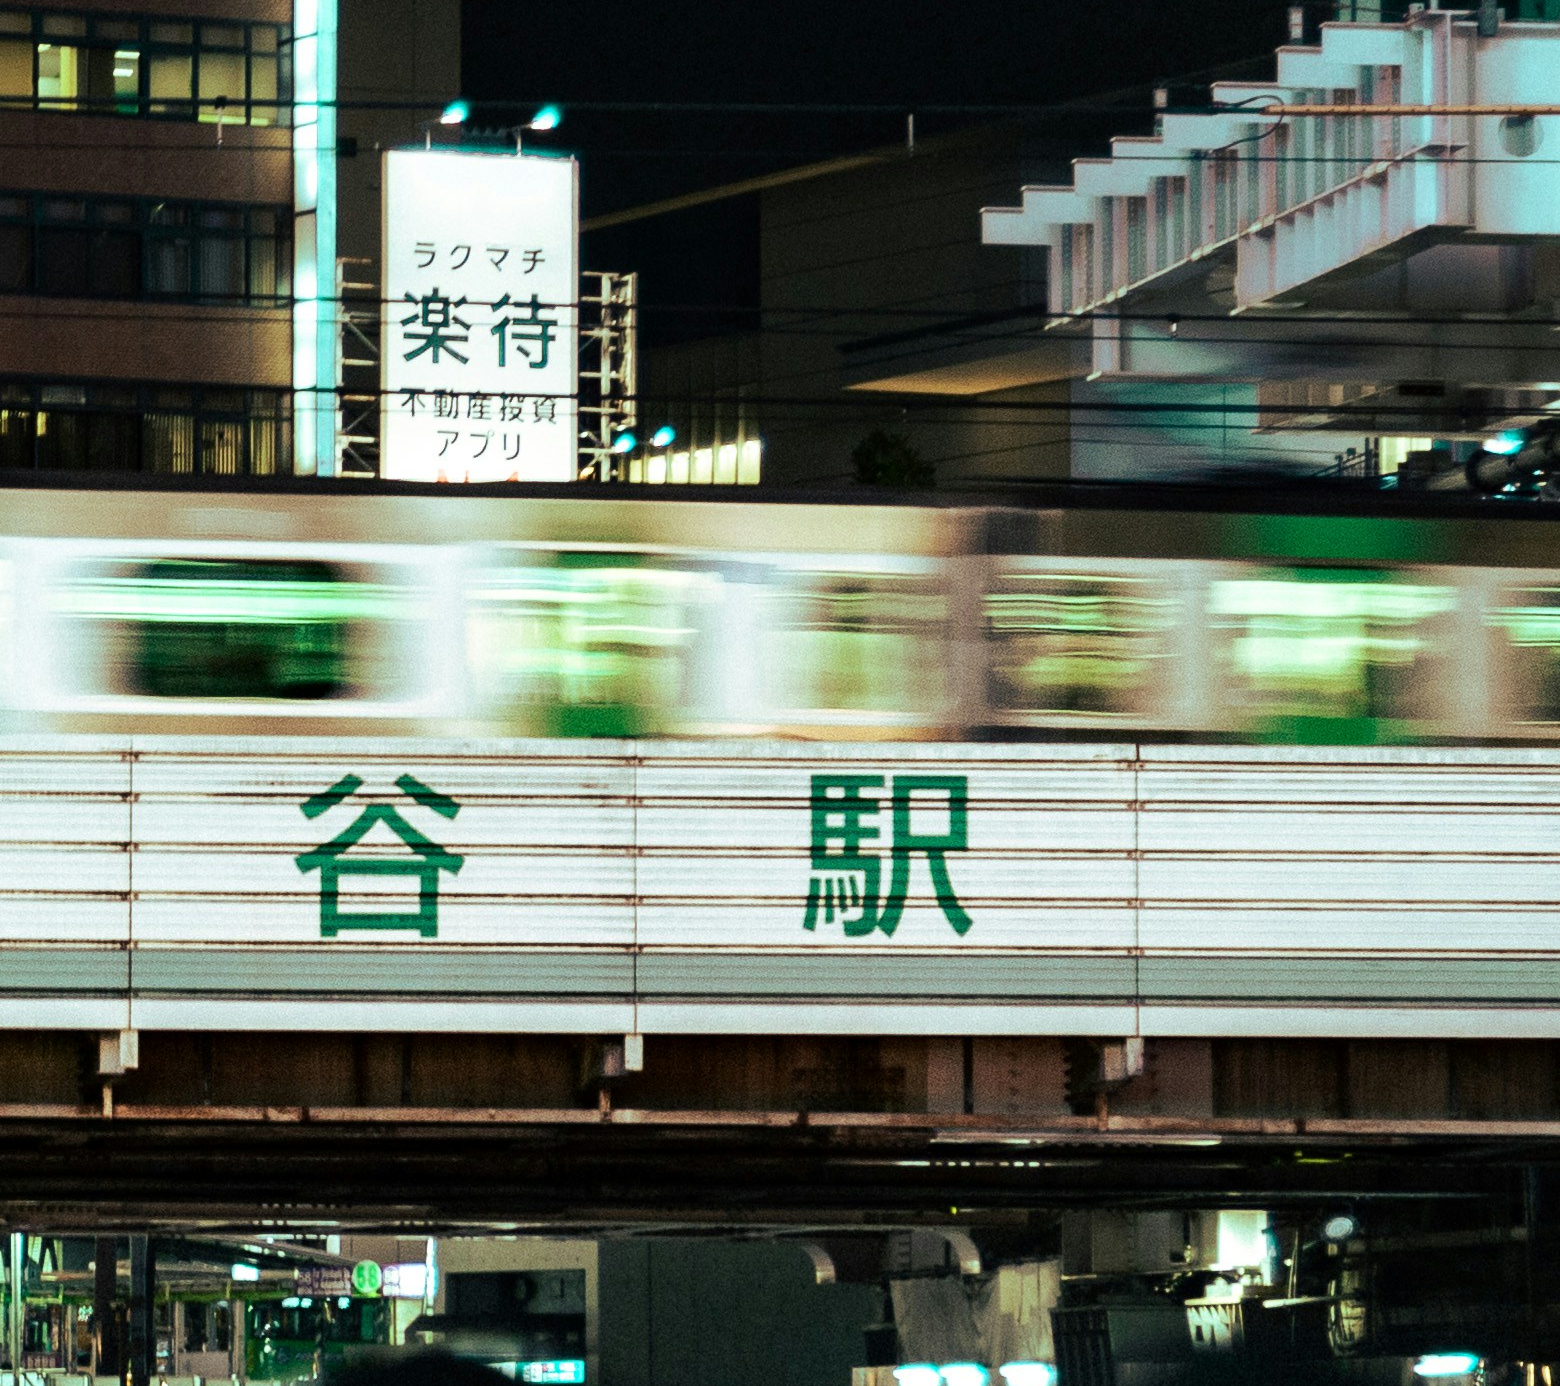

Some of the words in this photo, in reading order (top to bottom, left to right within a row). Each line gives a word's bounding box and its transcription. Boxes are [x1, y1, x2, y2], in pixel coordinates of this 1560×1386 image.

[414, 242, 546, 274] ラクマチ
[400, 286, 558, 369] 楽待
[400, 388, 557, 425] 不動産投資
[437, 429, 521, 461] アプリ
